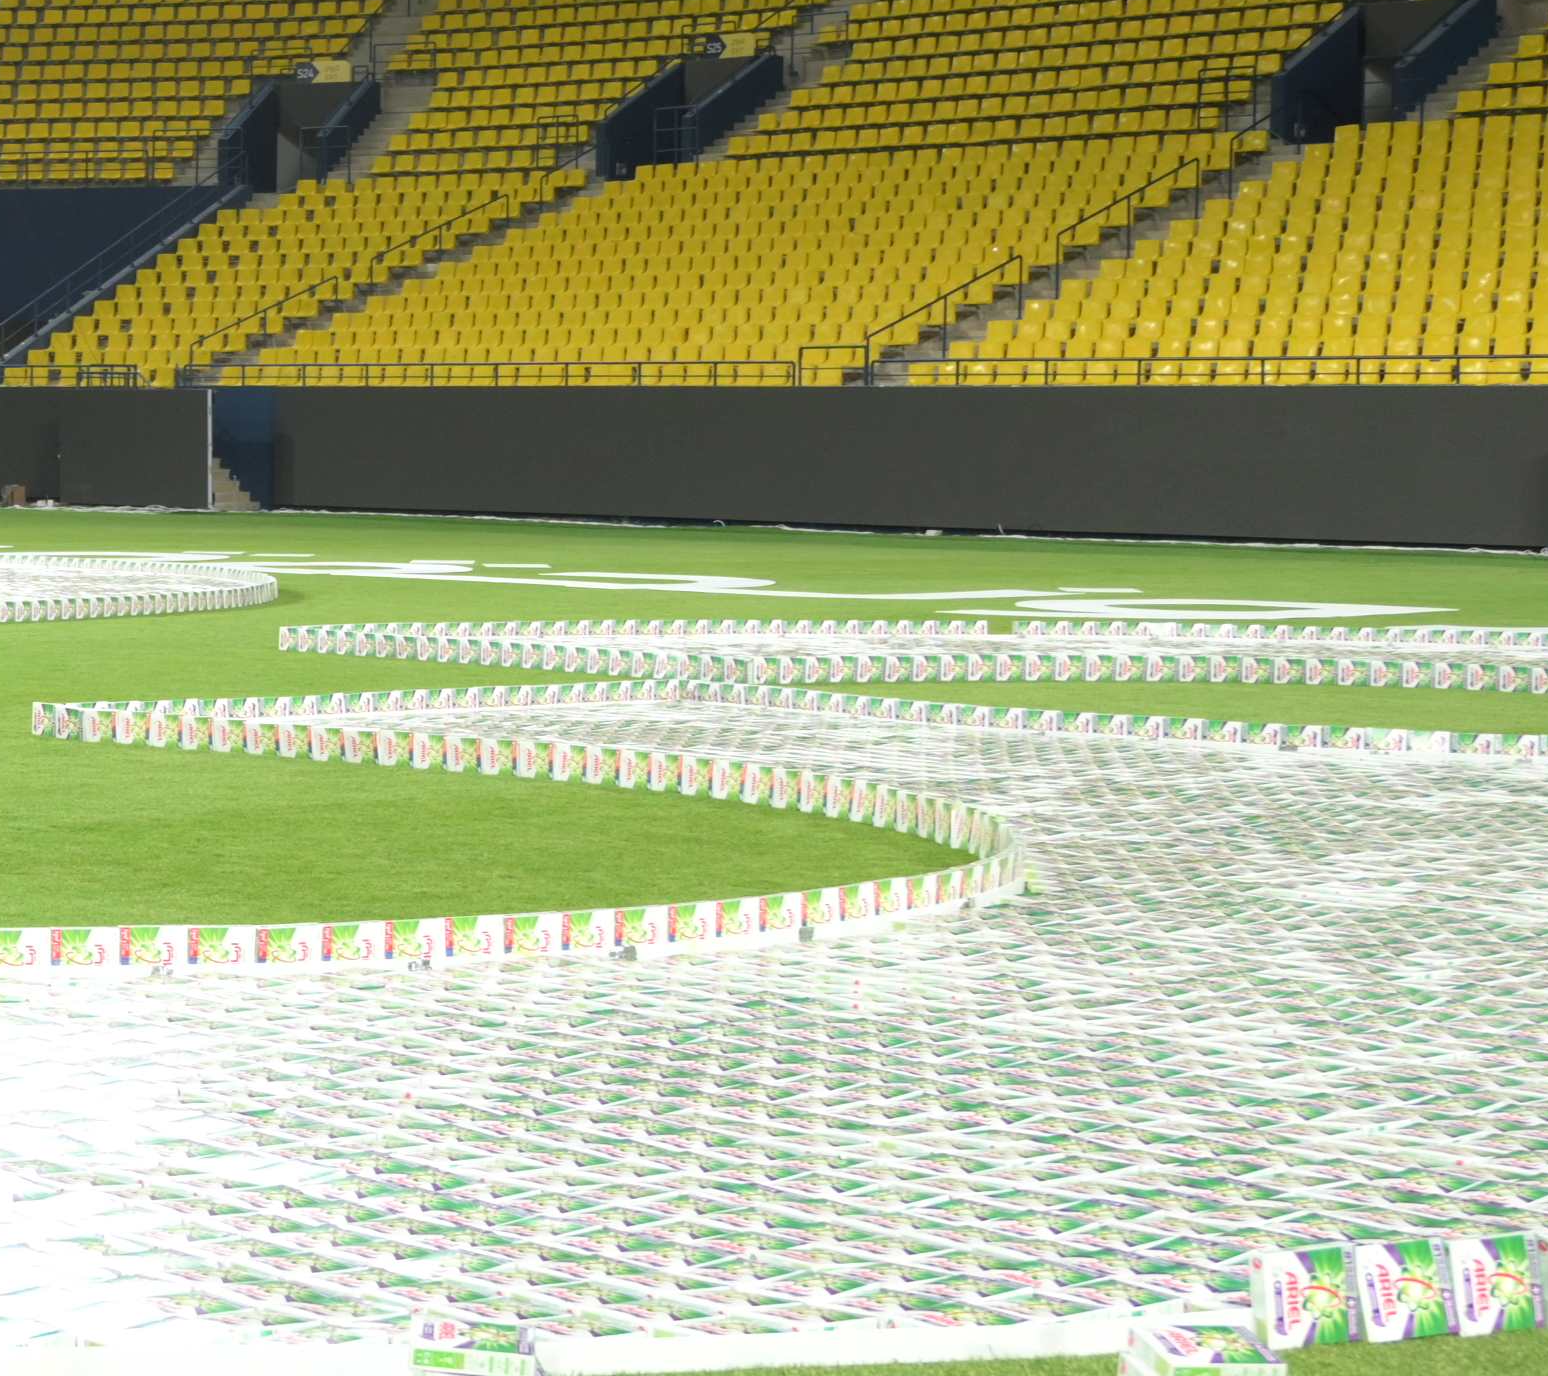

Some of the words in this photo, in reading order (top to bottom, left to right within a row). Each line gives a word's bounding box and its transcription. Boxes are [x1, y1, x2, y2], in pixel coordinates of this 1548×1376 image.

[296, 69, 314, 79] S24
[1285, 1271, 1301, 1327] ARIEL
[1375, 1264, 1397, 1319] ARIEL
[1472, 1259, 1490, 1312] ARIEL
